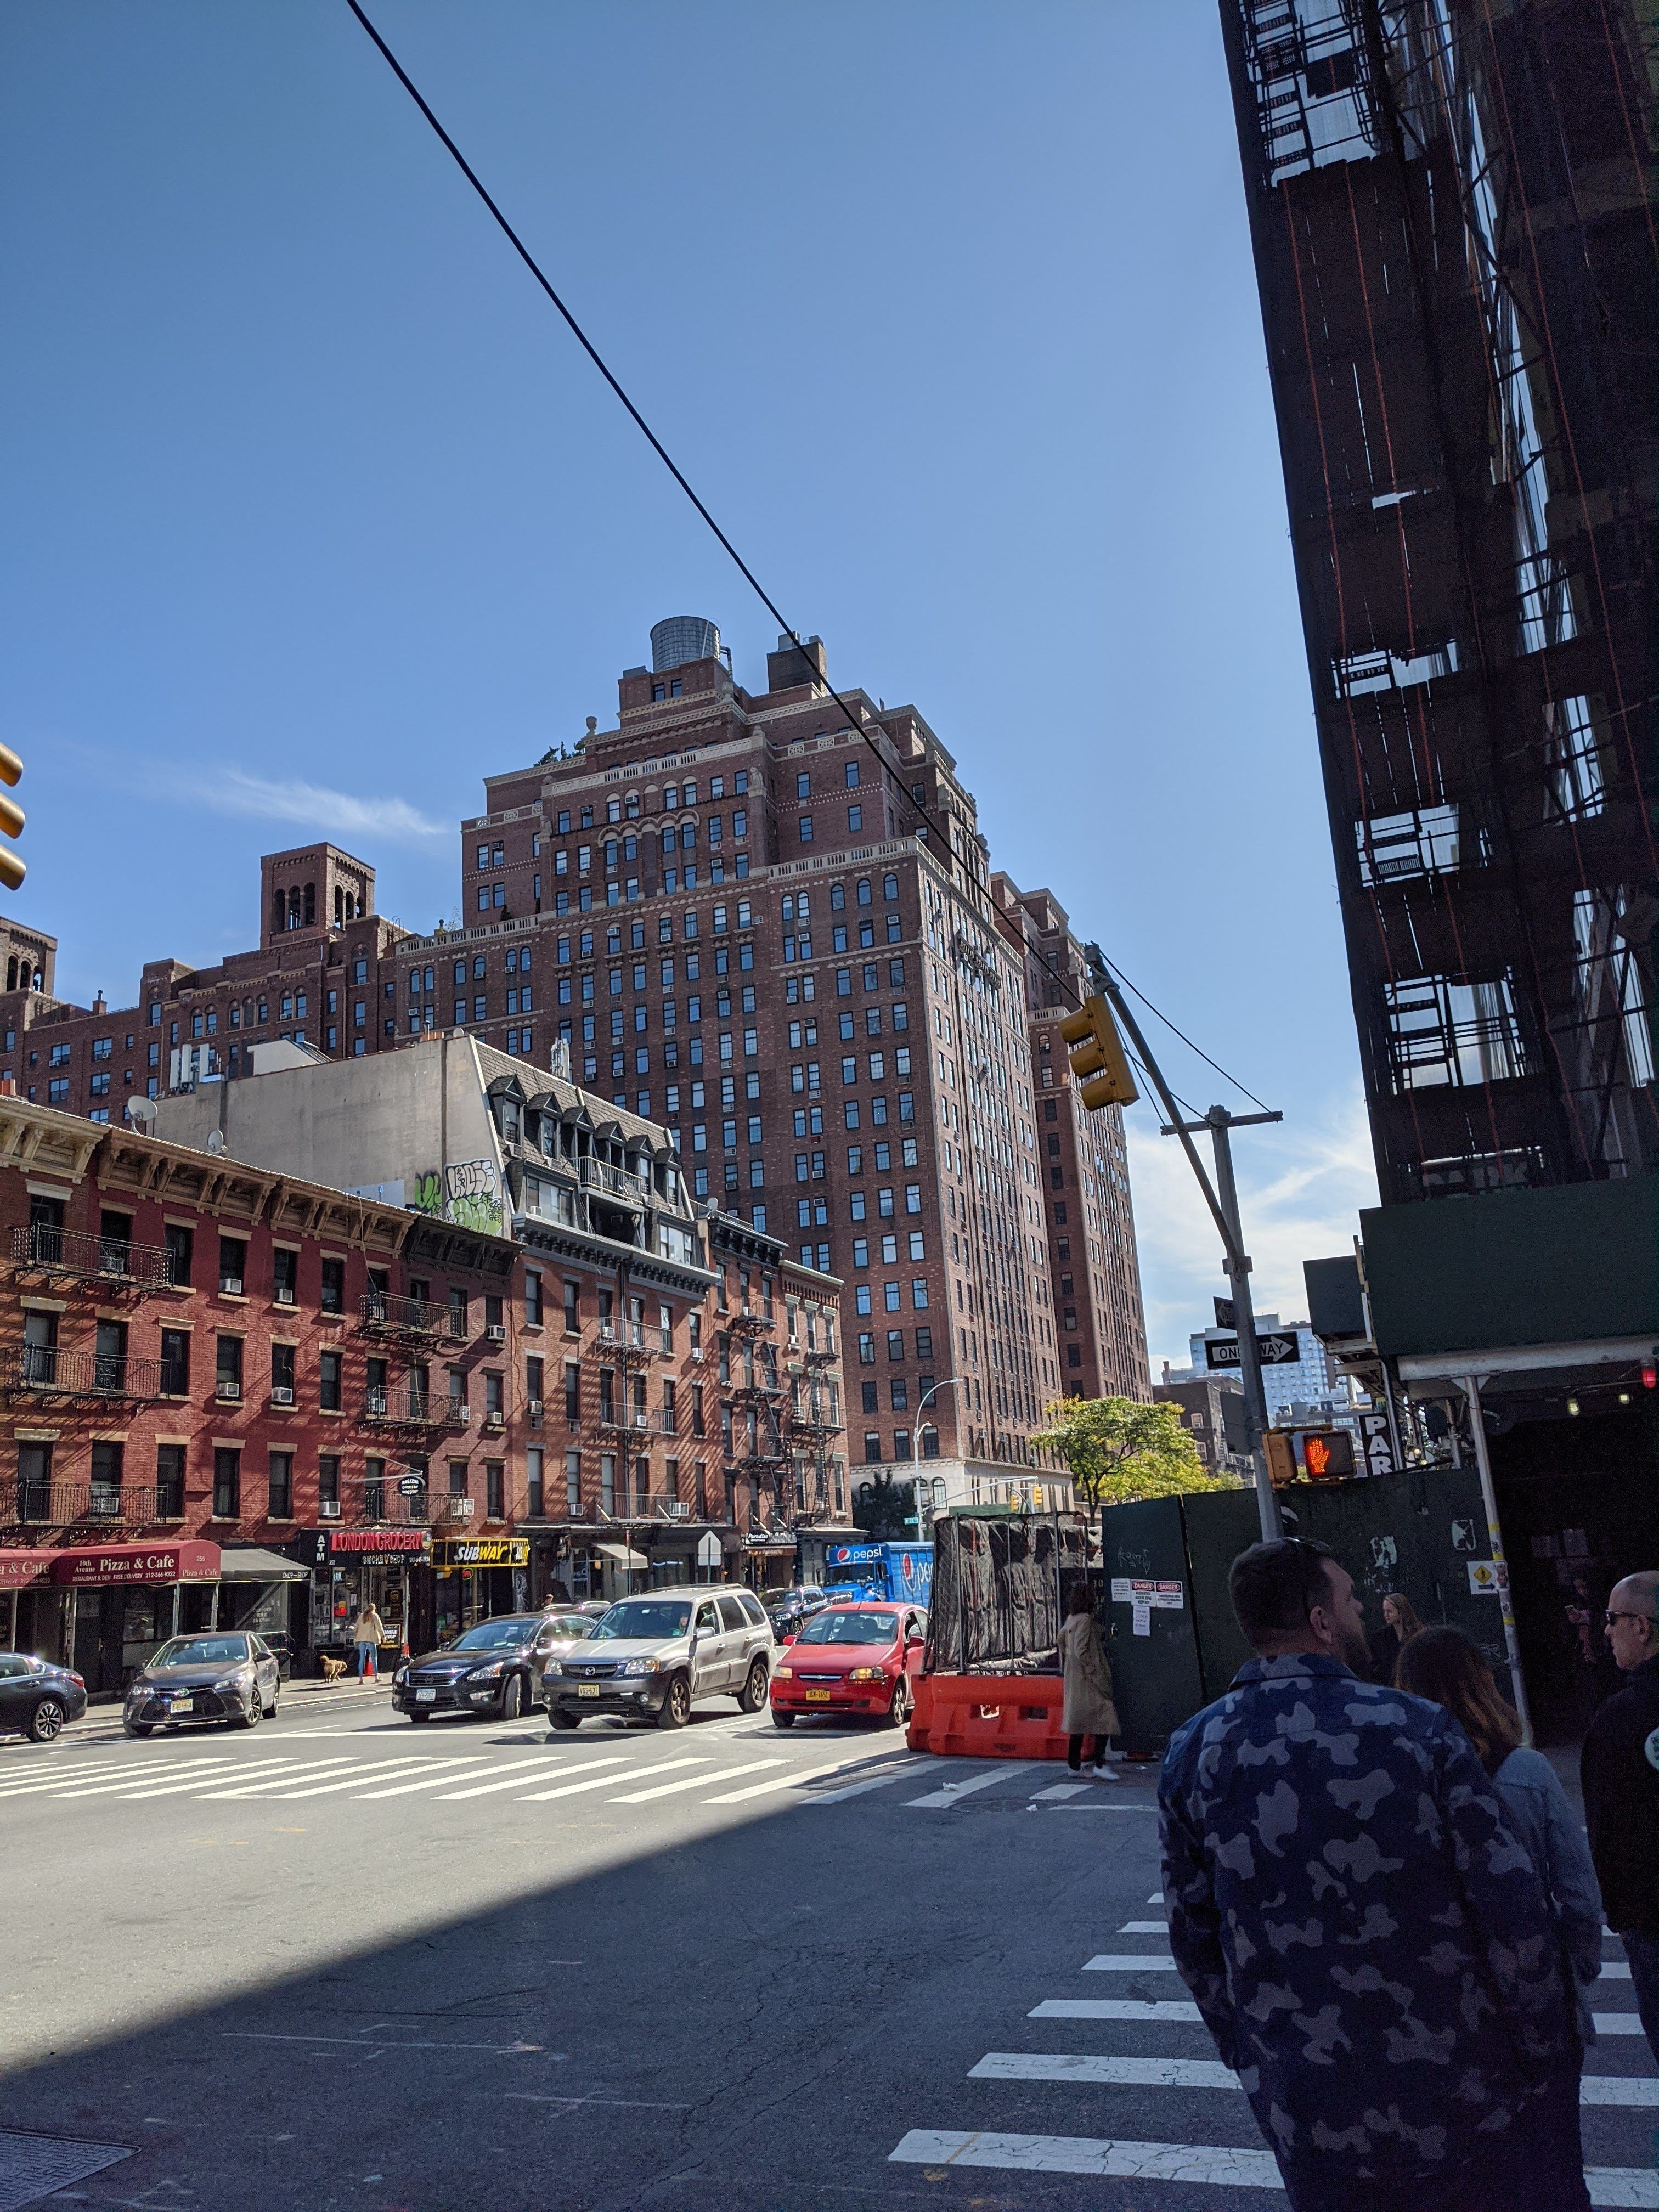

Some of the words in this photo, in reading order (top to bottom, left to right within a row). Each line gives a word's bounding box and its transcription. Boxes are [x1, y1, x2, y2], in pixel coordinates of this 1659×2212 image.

[316, 1534, 326, 1561] ATM
[331, 1532, 375, 1551] LONDON
[376, 1531, 423, 1551] GROCERY
[454, 1545, 509, 1561] SUBWAY
[853, 1547, 883, 1560] pepsi
[9, 1563, 19, 1574] &
[22, 1561, 50, 1575] Cafe
[99, 1559, 131, 1572] Pizza
[133, 1558, 144, 1569] &
[146, 1555, 174, 1569] Cafe
[183, 1568, 198, 1577] Pizza
[205, 1568, 218, 1576] Cafe
